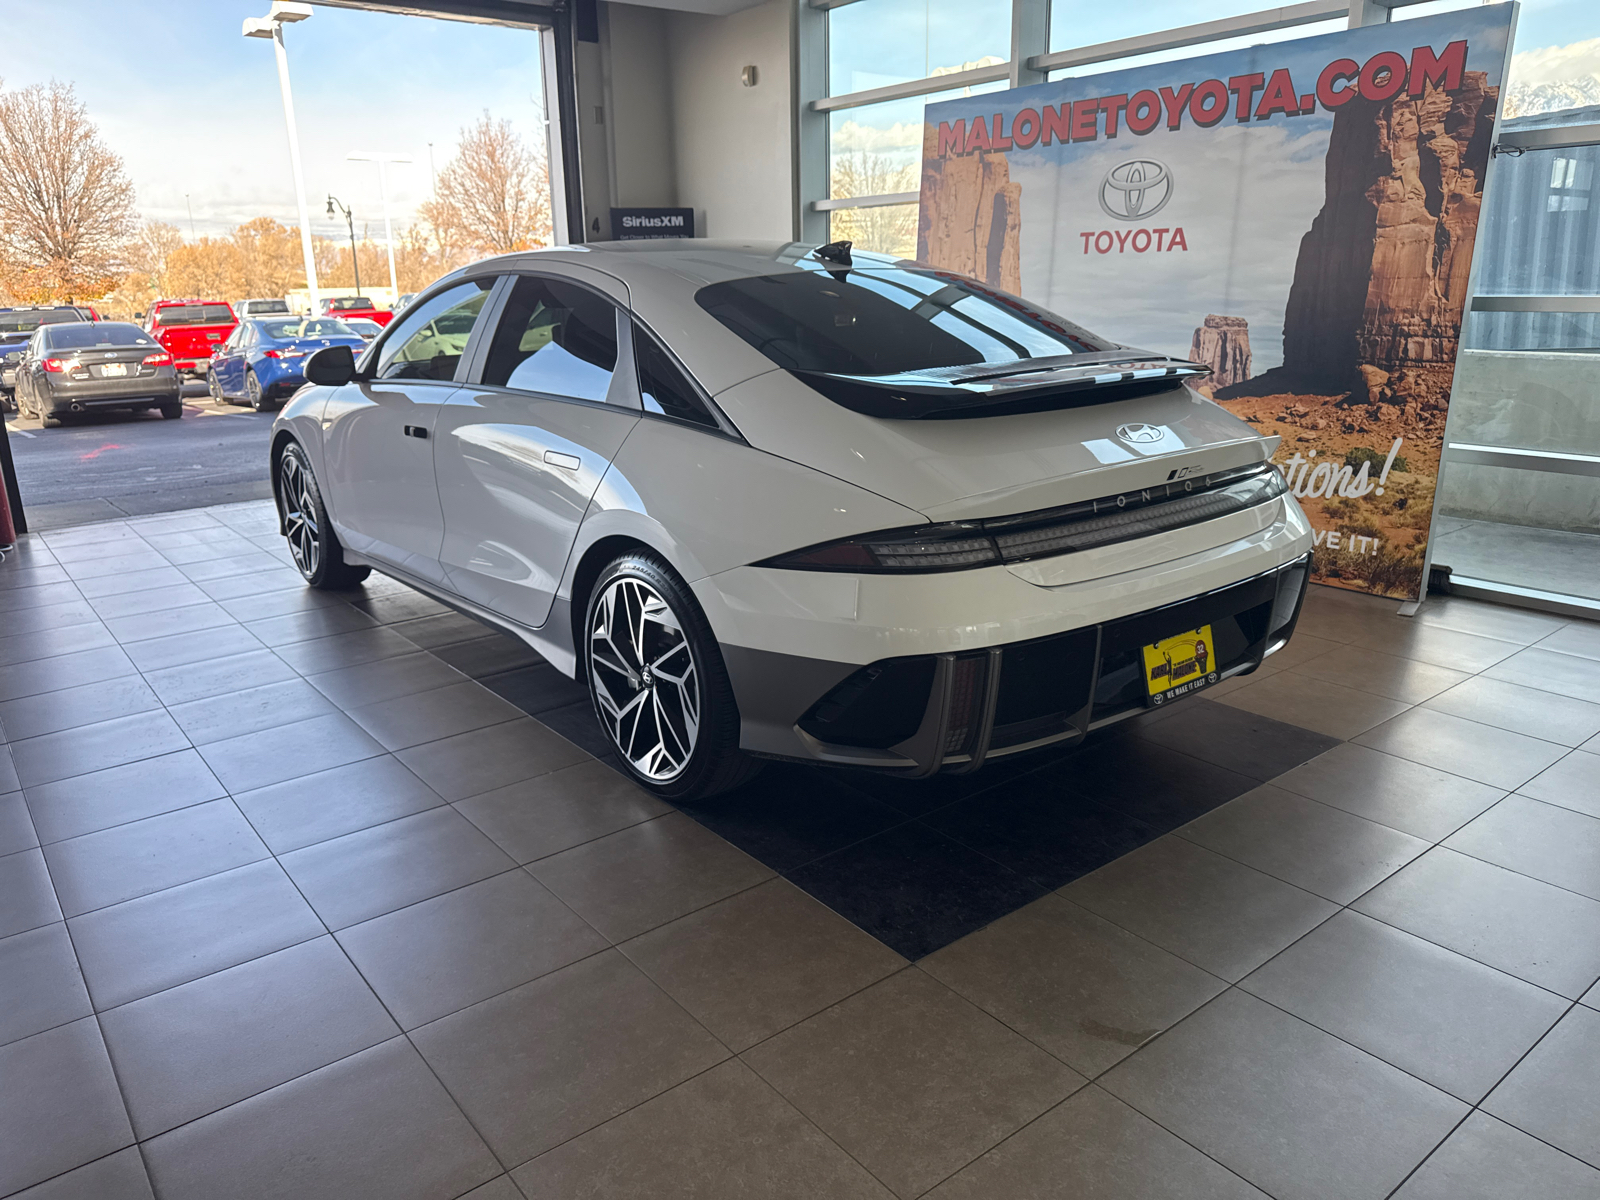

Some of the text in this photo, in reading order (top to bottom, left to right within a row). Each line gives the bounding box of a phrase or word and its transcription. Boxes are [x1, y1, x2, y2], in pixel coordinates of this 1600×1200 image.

[938, 39, 1468, 160] MALONETOYOTA.COM
[592, 216, 600, 234] 4
[622, 215, 684, 228] SiriusXM
[1080, 227, 1188, 255] TOYOTA
[1277, 437, 1403, 499] tions!
[1311, 528, 1379, 556] VE IT!
[1196, 644, 1205, 654] 32
[1166, 677, 1206, 699] WE MAKE IT EASY
